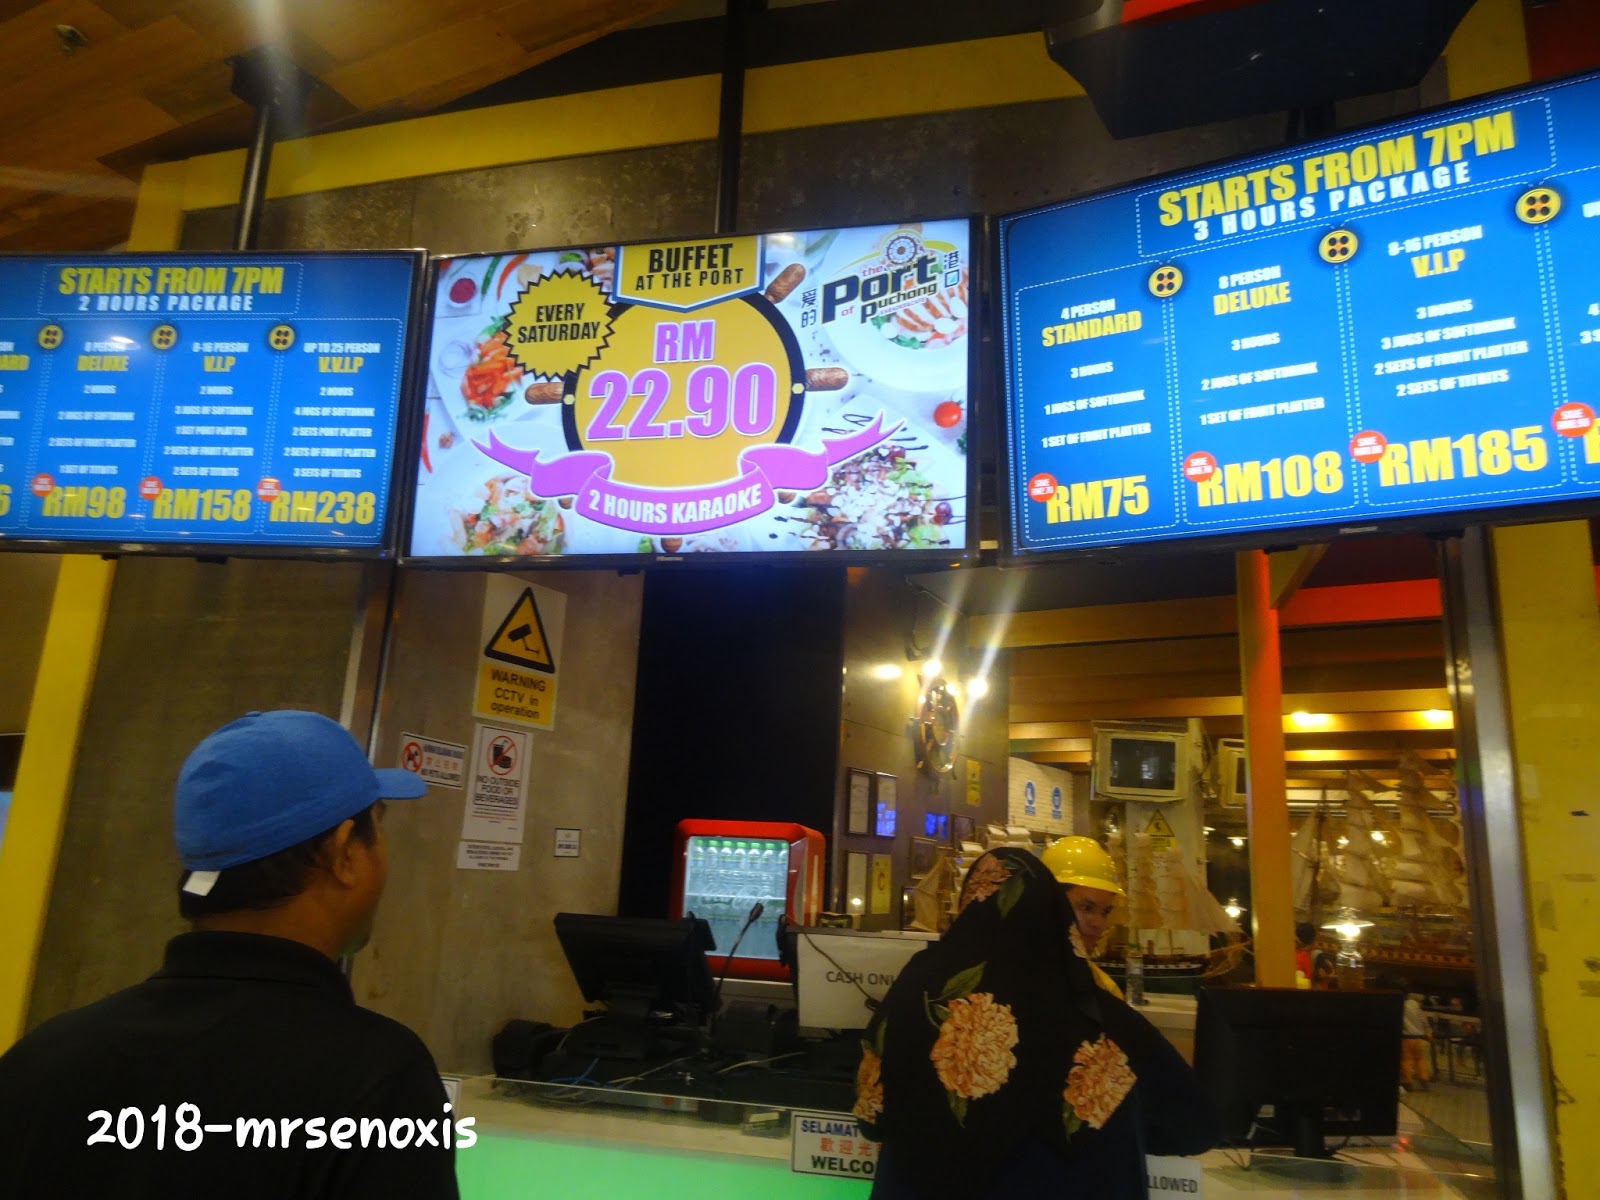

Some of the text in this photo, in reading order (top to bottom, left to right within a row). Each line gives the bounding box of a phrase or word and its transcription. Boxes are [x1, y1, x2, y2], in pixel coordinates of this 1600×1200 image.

[1158, 111, 1515, 227] STARTS FROM 7PM
[1193, 162, 1471, 241] 3 HOURS PACKAGE
[1423, 224, 1483, 249] PERSON
[648, 243, 733, 273] BUFFET
[1411, 248, 1465, 278] V.I.P
[59, 267, 285, 295] STARTS FROM 7PM
[635, 268, 744, 291] AT THE PORT
[862, 264, 883, 278] the
[1218, 265, 1281, 290] 8 PERSON
[822, 254, 937, 325] Port
[1213, 281, 1292, 316] DELUXE
[77, 295, 253, 311] 2 HOURS PACKAGE
[536, 303, 585, 323] EVERY
[841, 306, 854, 317] of
[1061, 298, 1116, 320] 4 PERSON
[1416, 299, 1473, 319] 3 HOURS
[517, 321, 600, 343] SATURDAY
[1042, 310, 1142, 347] STANDARD
[1381, 337, 1391, 350] 3
[1424, 329, 1442, 343] OF
[214, 342, 249, 353] PERSON
[303, 342, 318, 353] UP
[318, 342, 330, 353] TO
[344, 342, 381, 353] PERSON
[653, 319, 716, 364] RM
[1231, 339, 1240, 351] 3
[76, 355, 129, 372] DELUXE
[1374, 363, 1384, 375] 2
[1384, 358, 1416, 374] SETS
[1416, 355, 1433, 369] OF
[1472, 340, 1529, 361] PLATTER
[1070, 367, 1078, 379] 3
[1201, 379, 1210, 391] 2
[1396, 384, 1406, 397] 2
[1406, 379, 1439, 395] SETS
[1439, 376, 1456, 390] OF
[585, 362, 777, 441] 22.90
[1207, 411, 1227, 425] SET
[1276, 396, 1325, 415] PLATTER
[1378, 425, 1548, 487] RM185
[1197, 451, 1344, 507] RM108
[42, 486, 127, 519] RM98
[152, 489, 252, 522] RM158
[269, 491, 376, 525] RM238
[589, 483, 762, 524] 2 HOURS KARAOKE
[1046, 475, 1150, 524] RM75
[491, 668, 546, 692] WARNING
[495, 687, 525, 703] CCTV
[491, 702, 539, 719] operation
[489, 776, 520, 788] OUTSIDE
[826, 971, 863, 984] CASH
[802, 1119, 859, 1138] SELAMAT
[811, 1154, 874, 1175] WELCO
